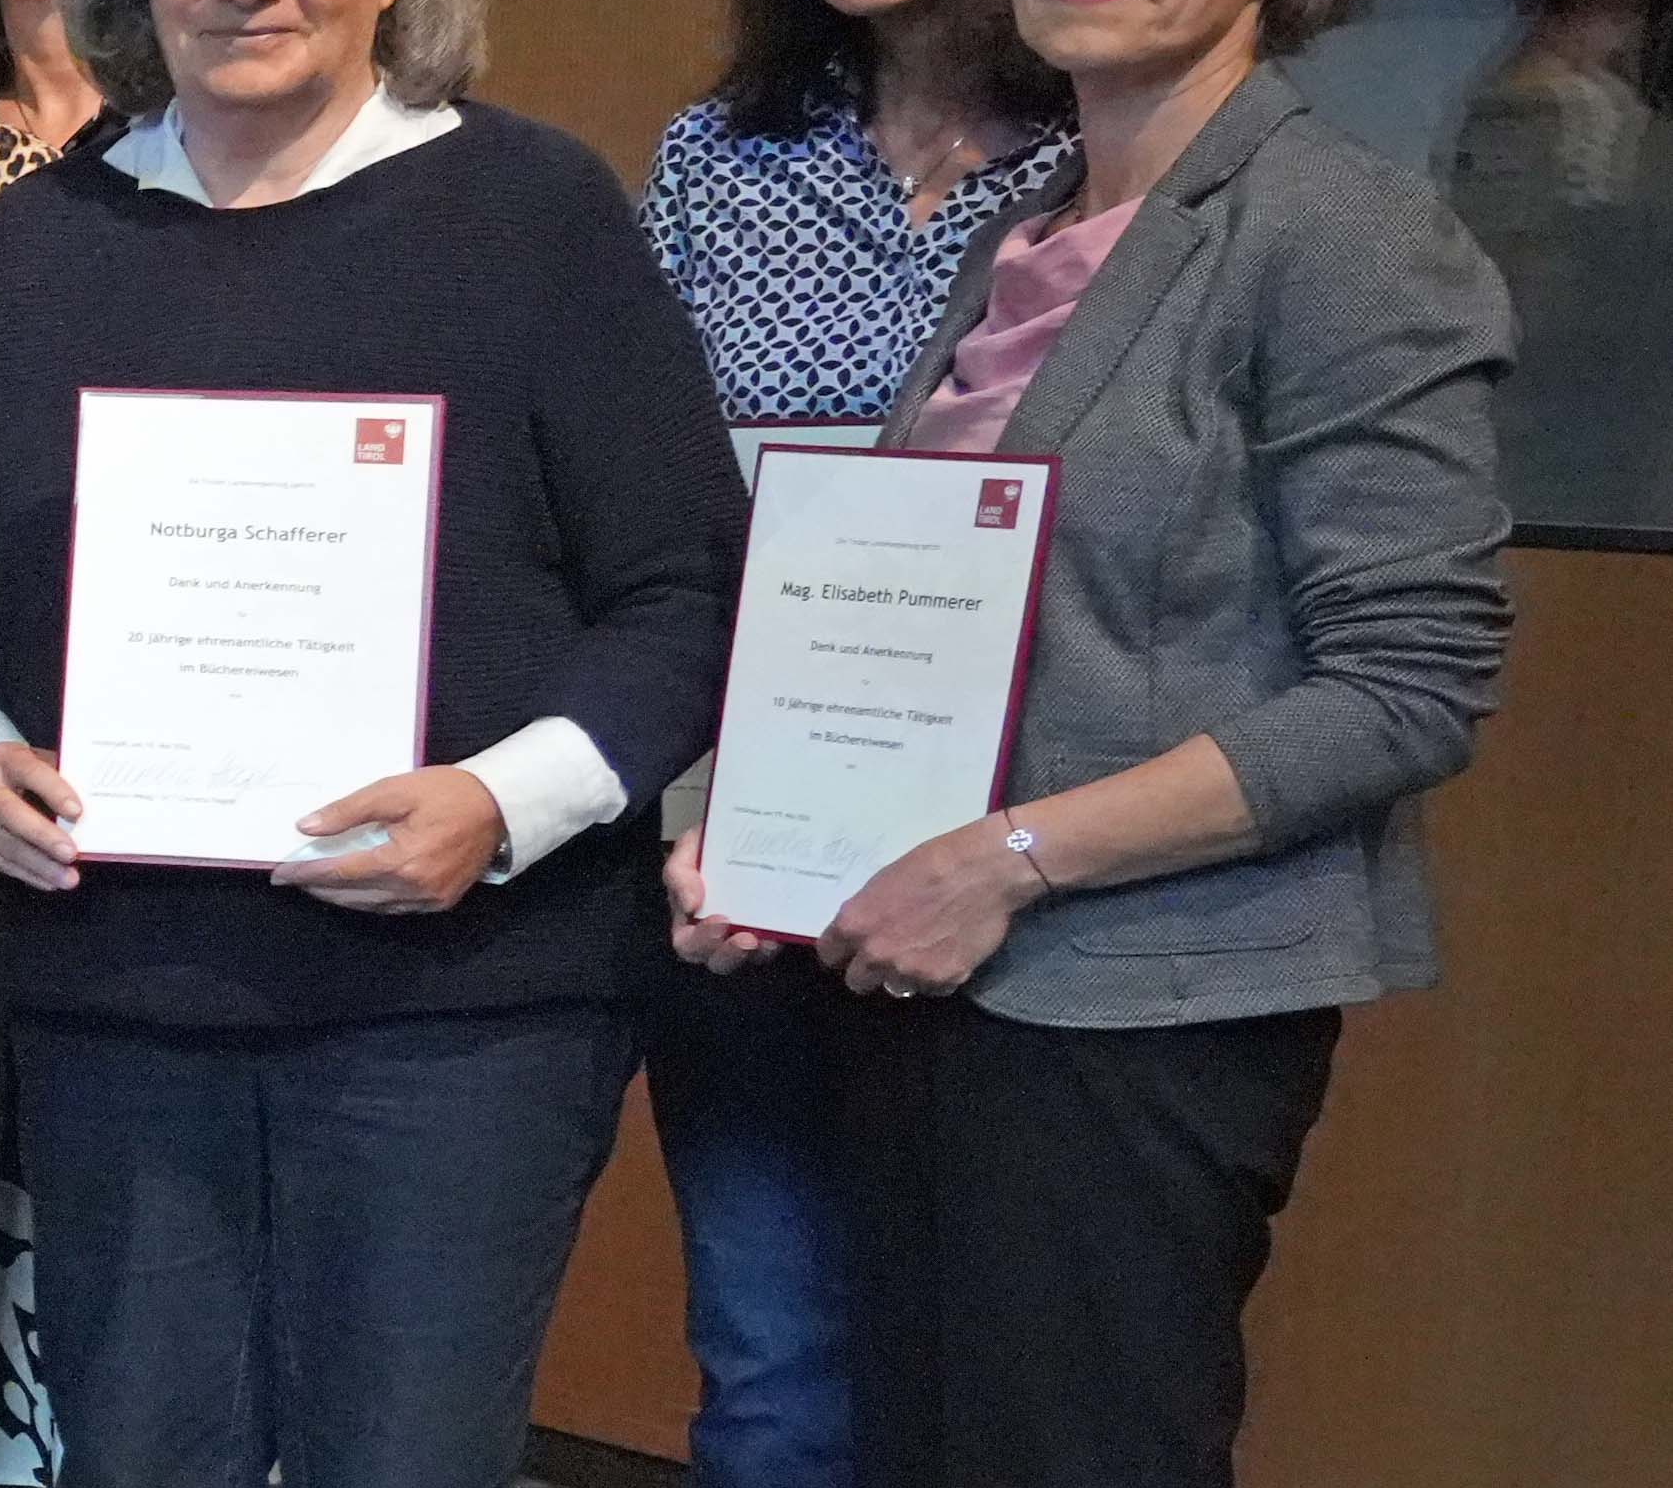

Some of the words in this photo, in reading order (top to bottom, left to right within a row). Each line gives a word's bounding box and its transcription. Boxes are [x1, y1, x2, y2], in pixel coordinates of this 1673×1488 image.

[356, 443, 386, 452] LAND
[150, 521, 238, 543] Notburga
[244, 523, 348, 545] Schafferer
[168, 576, 200, 588] Dank
[205, 577, 229, 590] und
[233, 579, 323, 596] Anerkennung
[780, 580, 815, 602] Mag.
[821, 583, 893, 605] Elisabeth
[898, 588, 984, 613] Pummerer
[127, 631, 144, 643] 20
[197, 635, 293, 650] ehrenamtliche
[297, 637, 356, 655] Tätigkeit
[810, 640, 836, 653] Dank
[839, 642, 860, 656] und
[862, 644, 933, 665] Anerkennung
[179, 662, 195, 673] im
[199, 662, 300, 679] Büchereiwesen
[772, 696, 785, 708] 10
[826, 701, 903, 721] ehrenamtliche
